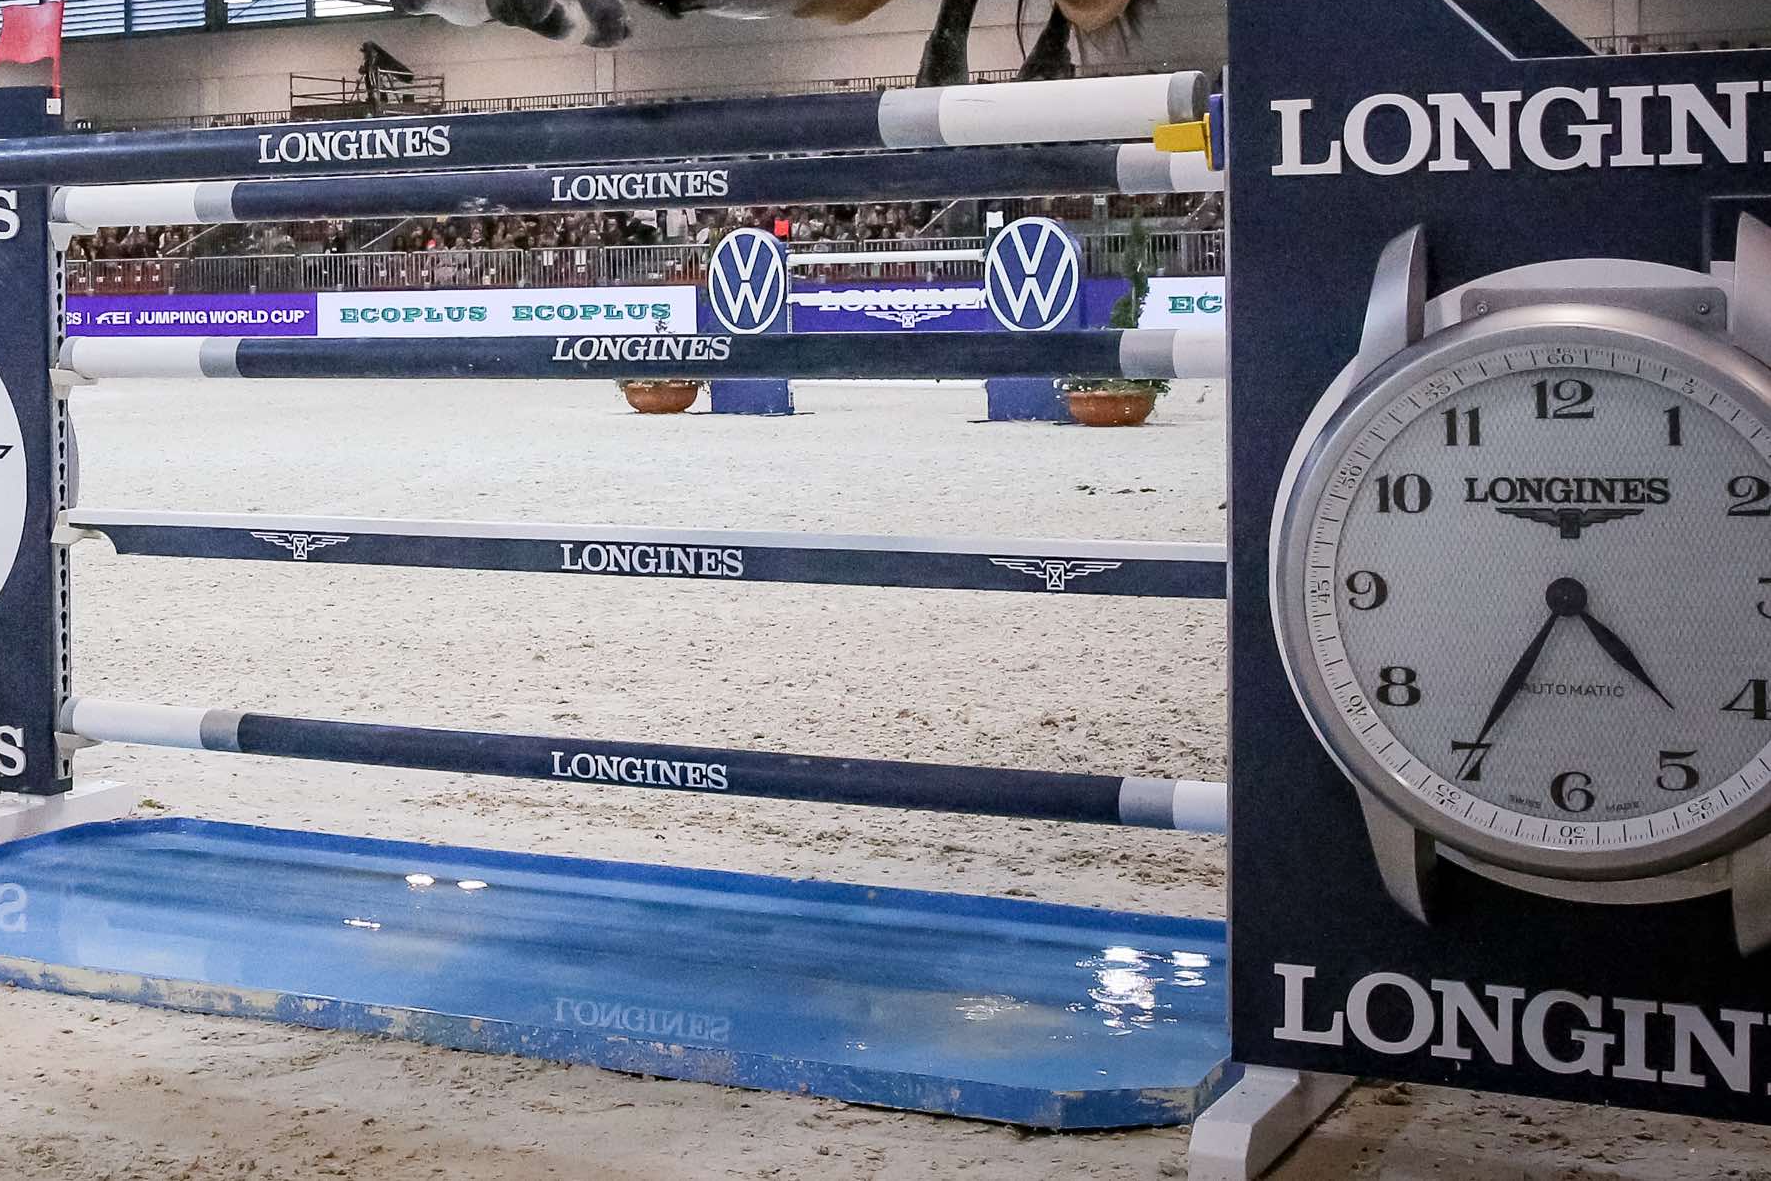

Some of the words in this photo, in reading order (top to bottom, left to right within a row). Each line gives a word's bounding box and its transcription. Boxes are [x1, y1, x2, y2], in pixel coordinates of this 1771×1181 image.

[258, 125, 450, 164] LONGINES
[1270, 81, 1771, 176] LONGIN
[551, 168, 729, 201] LONGINES
[136, 310, 208, 325] JUMPING
[209, 310, 269, 324] WORLD
[339, 305, 488, 324] ECOPLUS
[512, 302, 672, 322] ECOPLUS
[552, 336, 733, 361] LONGINES
[1530, 377, 1595, 419] 12
[1441, 406, 1482, 447] 11
[1663, 405, 1683, 447] 1
[1374, 473, 1433, 514] 10
[1464, 476, 1671, 505] LONGINES
[1728, 475, 1771, 517] 2
[560, 542, 745, 578] LONGINES
[1345, 569, 1389, 611] 9
[1376, 666, 1422, 707] 8
[551, 750, 729, 790] LONGINES
[1451, 739, 1493, 781] 7
[1656, 749, 1700, 792] 5
[1550, 771, 1595, 813] 6
[1273, 962, 1771, 1097] LONGIN
